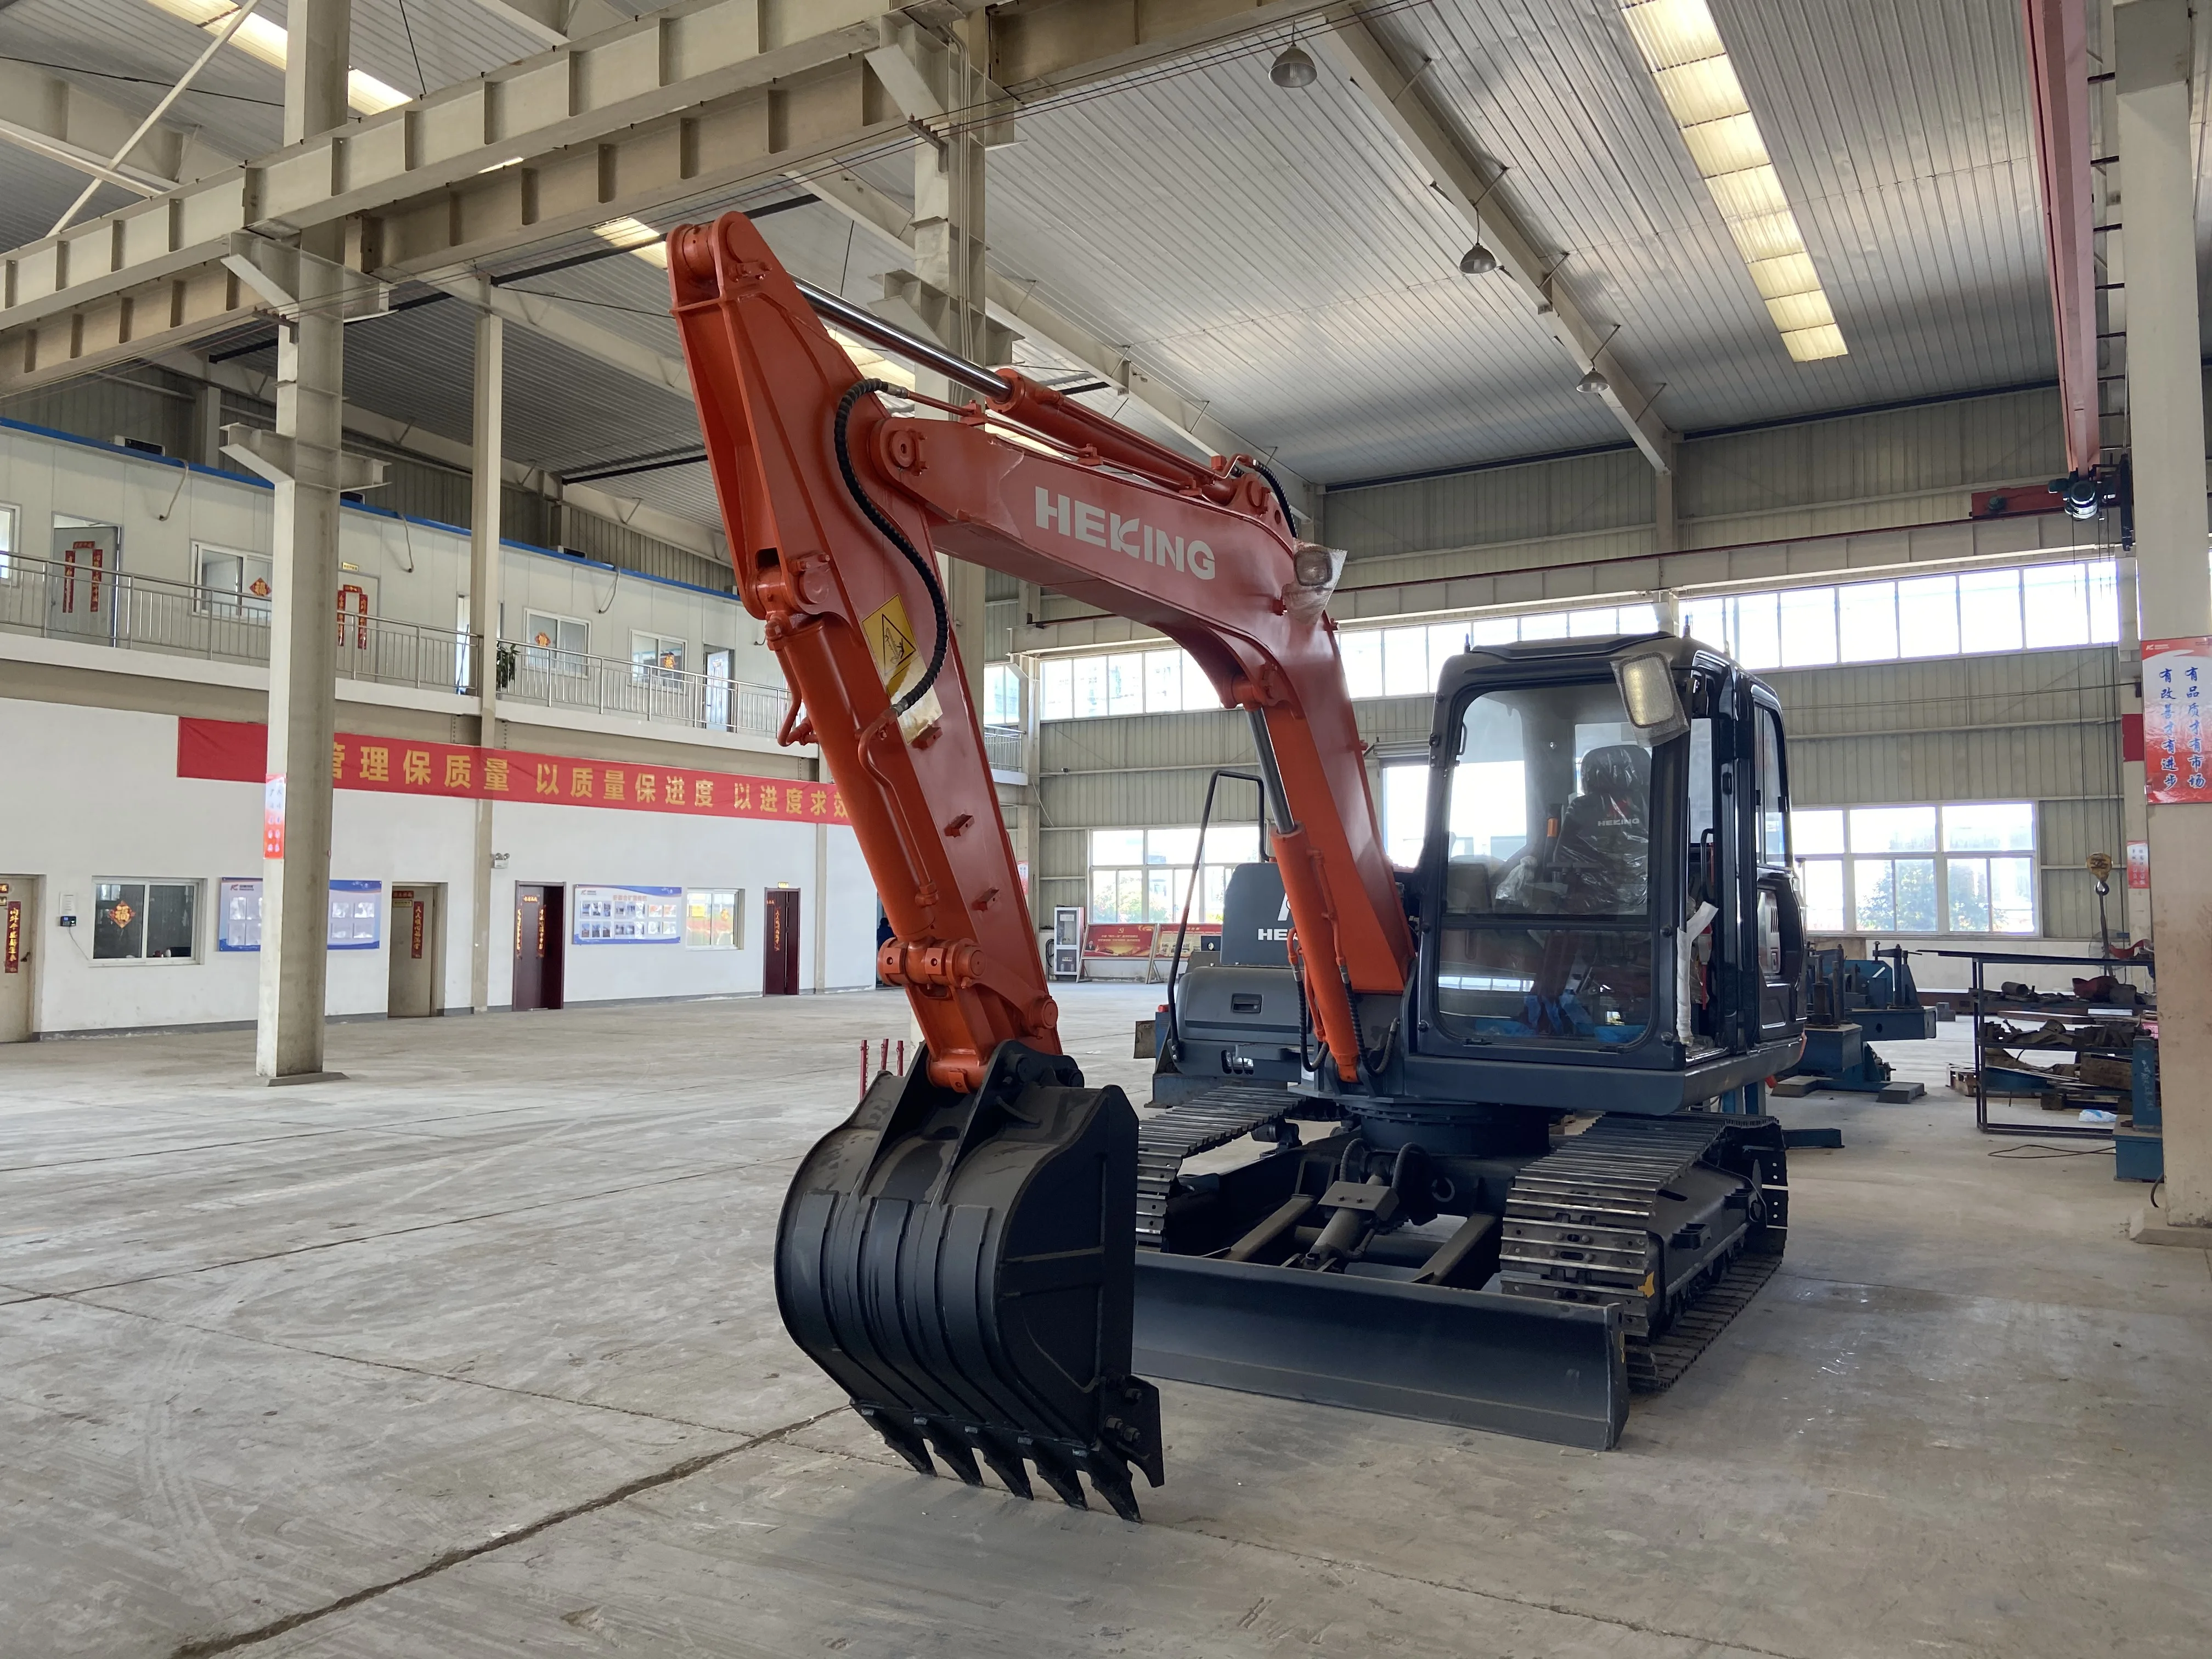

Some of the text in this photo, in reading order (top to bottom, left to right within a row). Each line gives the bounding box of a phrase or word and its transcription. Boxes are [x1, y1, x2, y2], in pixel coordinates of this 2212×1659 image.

[1036, 486, 1215, 580] HEKING
[2159, 668, 2179, 791] 有改善才有进步
[2185, 667, 2205, 788] 有品质才有市场
[536, 763, 714, 808] 以质量保进度
[1258, 928, 1299, 941] HE
